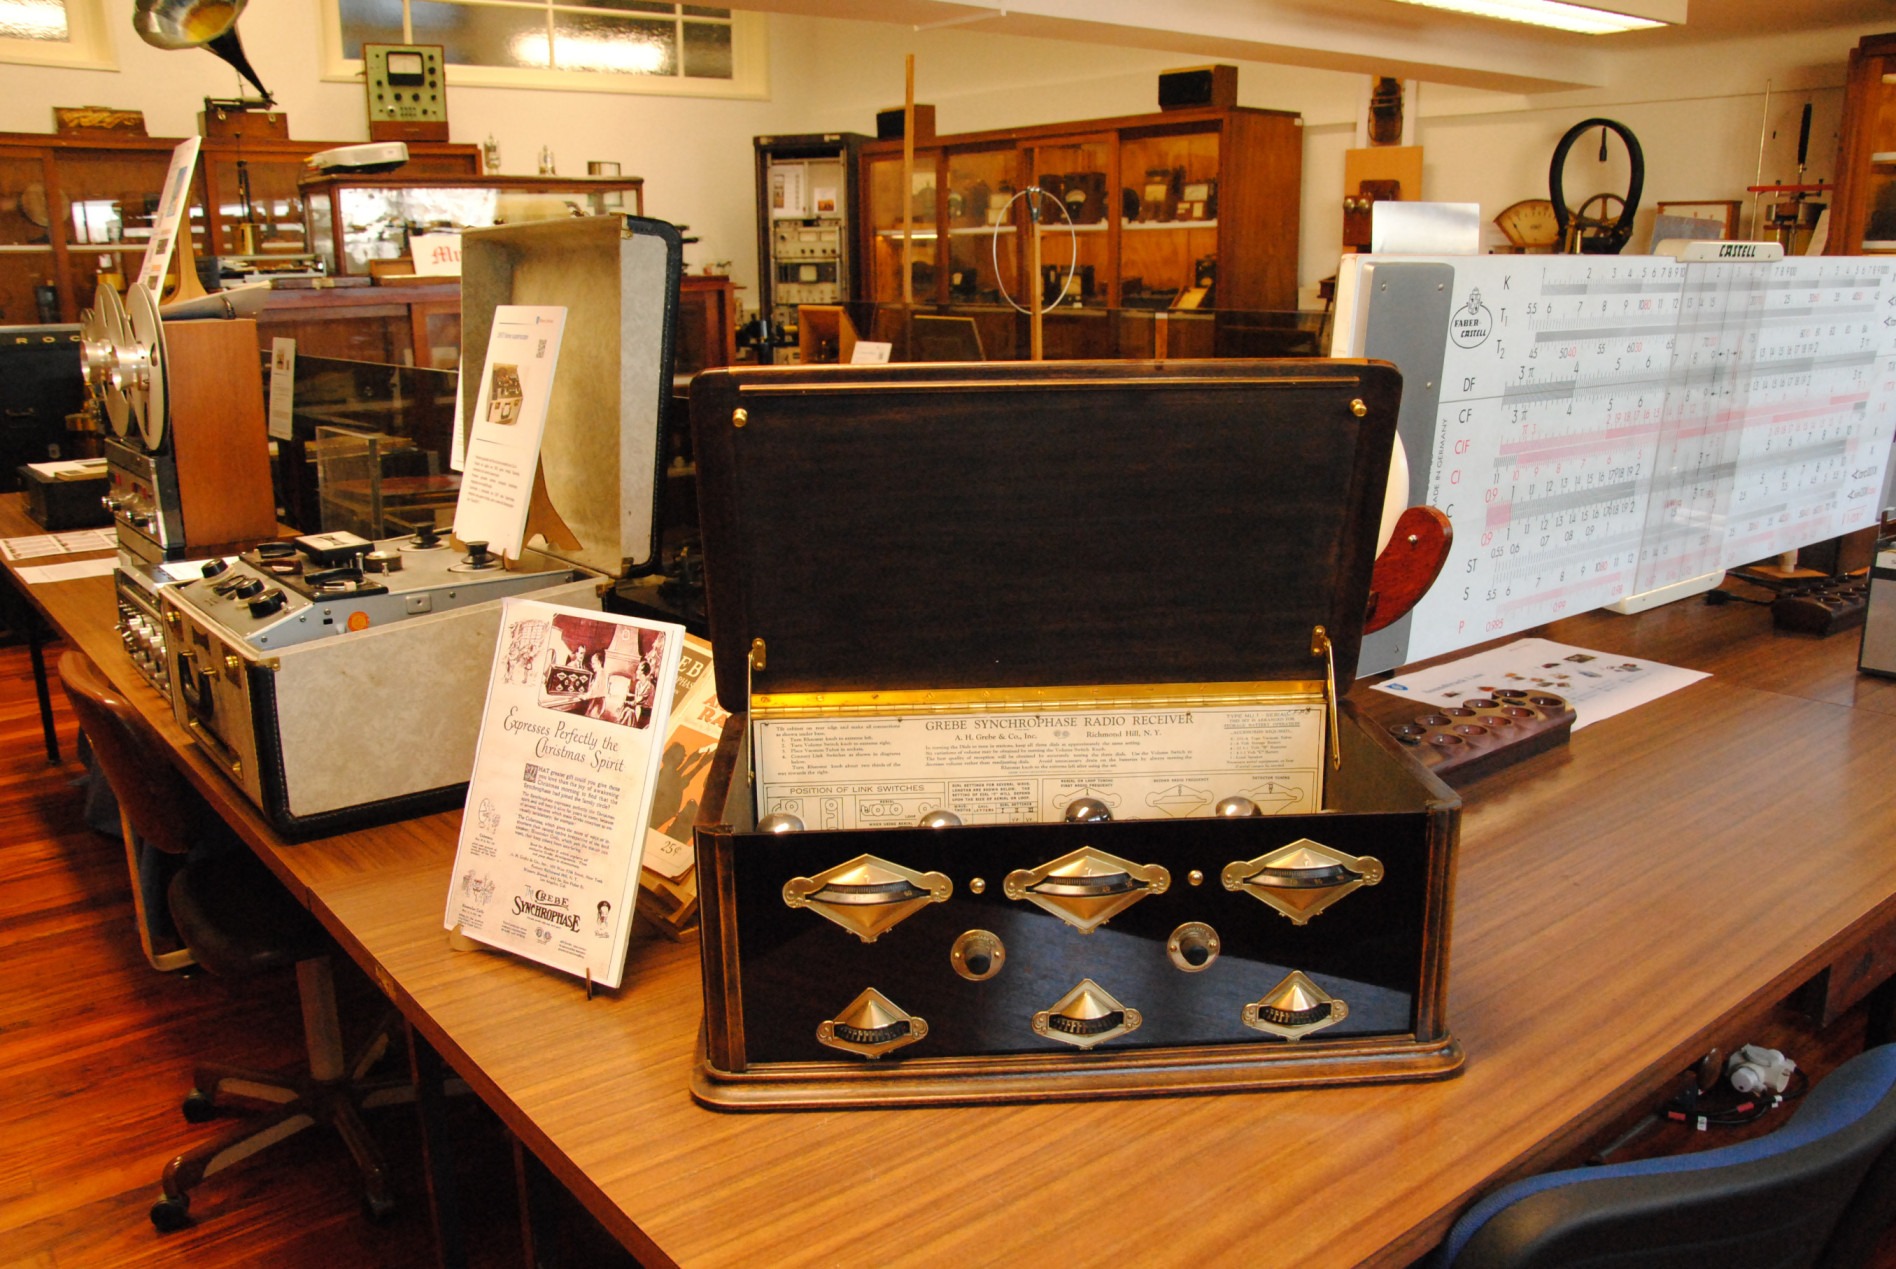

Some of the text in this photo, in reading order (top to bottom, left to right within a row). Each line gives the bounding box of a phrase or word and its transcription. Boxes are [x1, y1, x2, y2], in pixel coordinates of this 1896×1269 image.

[1718, 244, 1757, 258] CASTELL
[1504, 275, 1511, 290] K
[1587, 267, 1592, 279] 2
[1611, 267, 1617, 279] 3
[1642, 267, 1647, 278] 5
[1661, 267, 1666, 277] 7
[1547, 302, 1552, 314] 6
[1578, 301, 1583, 312] 7
[1602, 301, 1607, 311] 8
[1623, 300, 1628, 310] 9
[1461, 329, 1486, 338] CASTELL
[1529, 348, 1538, 359] 45
[1597, 344, 1606, 355] 55
[1463, 377, 1476, 392] DF
[1519, 366, 1525, 380] 3
[1573, 361, 1579, 373] 4
[1615, 358, 1621, 371] 5
[1646, 356, 1651, 368] 6
[1458, 408, 1472, 424] CF
[1511, 410, 1518, 424] 3
[1566, 403, 1572, 416] 4
[1607, 399, 1613, 411] 5
[1637, 396, 1643, 408] 6
[1437, 418, 1447, 468] GERMANY
[1454, 439, 1471, 455] CIF
[1450, 470, 1461, 485] CI
[1446, 504, 1454, 518] C
[1635, 464, 1641, 476] 2
[1630, 501, 1635, 513] 2
[1466, 558, 1477, 574] ST
[1463, 587, 1470, 601] S
[1506, 585, 1511, 596] 6
[1535, 577, 1541, 588] 7
[1559, 571, 1565, 582] 8
[1458, 620, 1465, 634] P
[503, 705, 619, 752] Expresses Perfectly the
[925, 714, 1194, 731] GREBE SYNCHROPHASE RADIO RECEIVER
[535, 736, 624, 773] Christmas Spirit
[537, 779, 560, 790] Christmas
[560, 786, 580, 797] morning
[599, 795, 609, 803] that
[558, 778, 569, 786] than
[569, 780, 578, 788] the
[577, 783, 586, 791] joy
[593, 788, 620, 800] awakening
[790, 787, 833, 795] POSITION
[836, 786, 849, 794] OF
[876, 784, 925, 793] SWITCHES
[511, 895, 581, 933] SYNCHROPHASE
